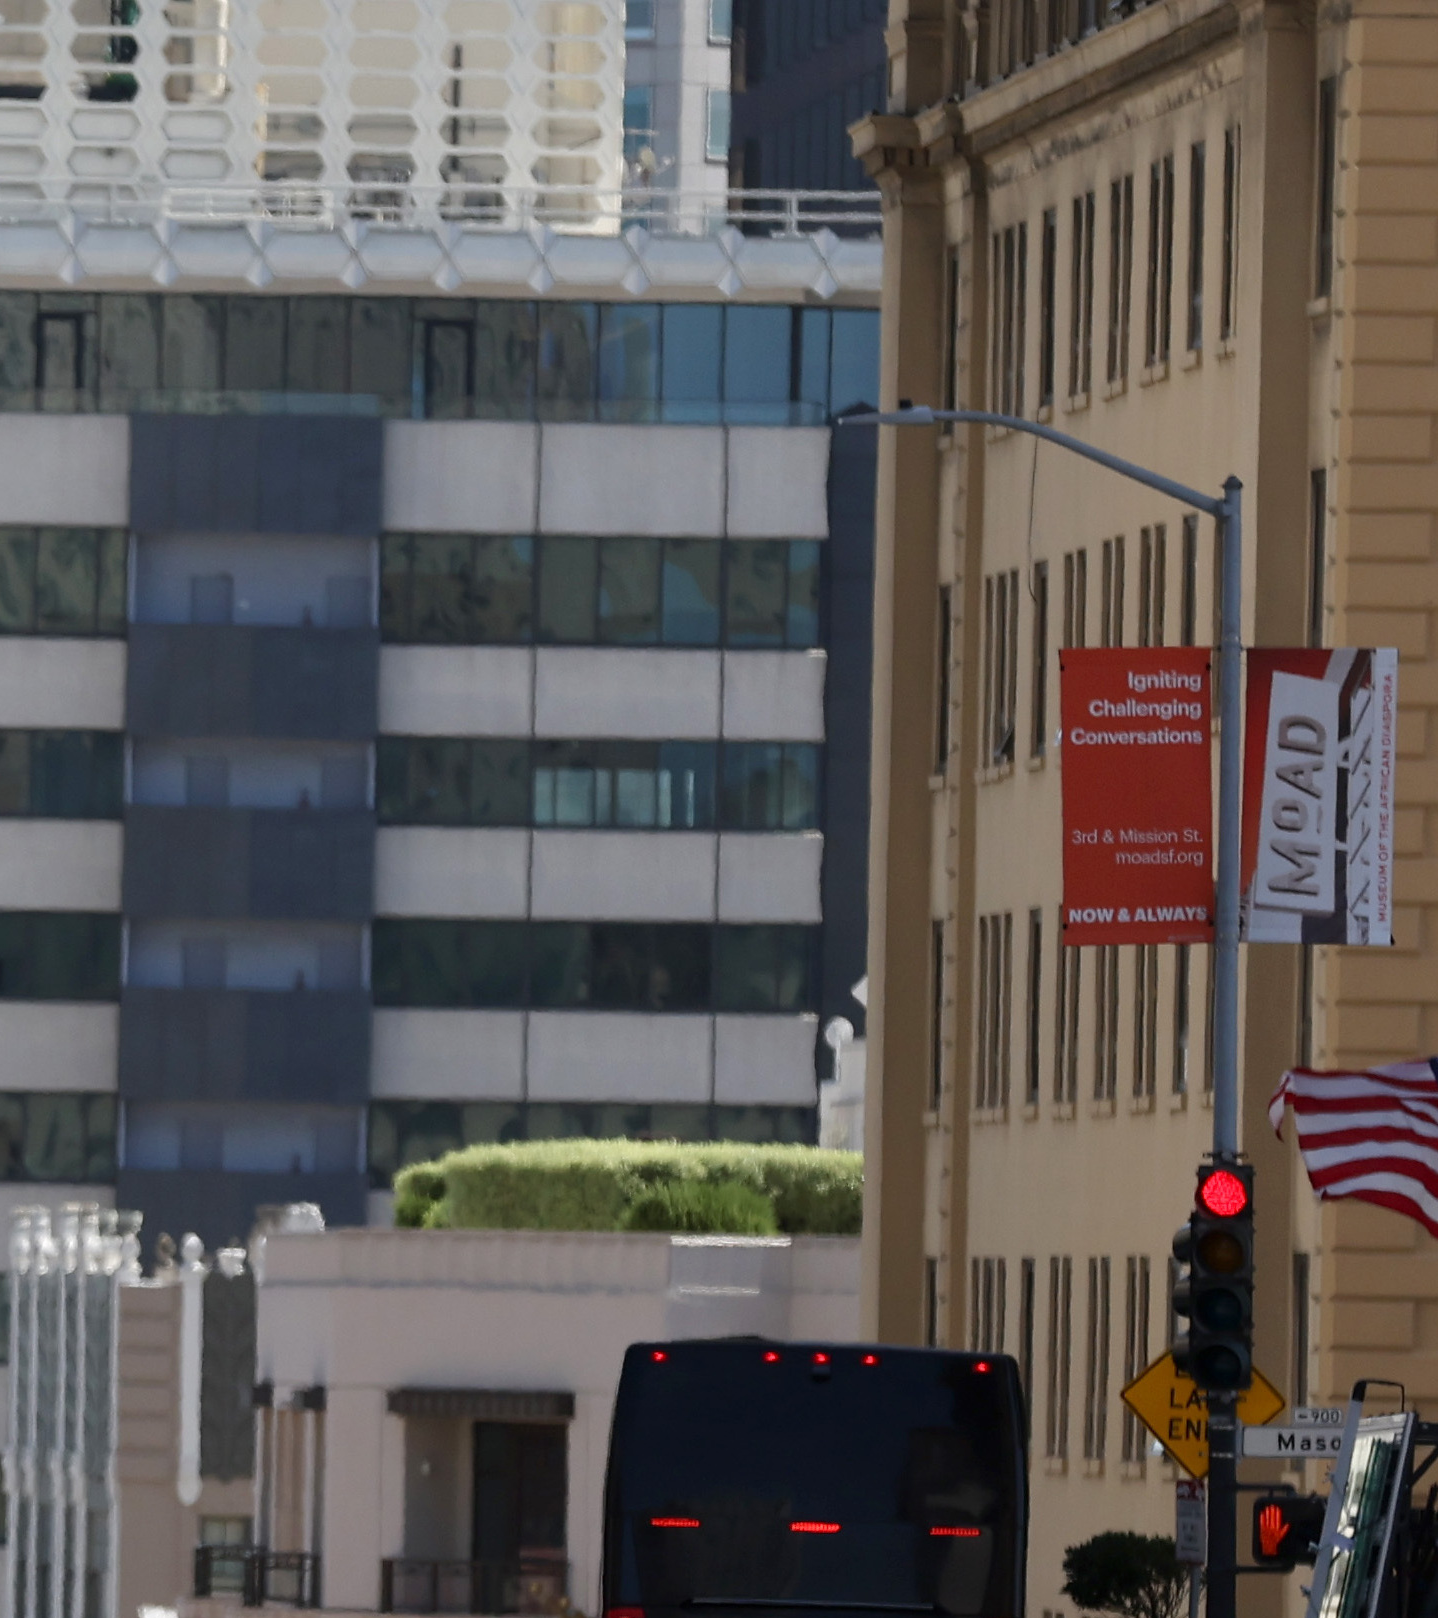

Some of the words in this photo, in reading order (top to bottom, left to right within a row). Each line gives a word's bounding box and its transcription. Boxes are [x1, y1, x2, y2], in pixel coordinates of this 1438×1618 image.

[1128, 671, 1202, 692] Igniting
[1089, 699, 1202, 720] Challenging
[1382, 674, 1393, 747] DIASPORA
[1070, 728, 1203, 746] Conversations
[1380, 750, 1391, 810] AFRICAN
[1072, 829, 1098, 844] 3rd
[1103, 829, 1115, 844] &
[1120, 828, 1178, 844] Mission
[1183, 828, 1203, 843] St.
[1380, 818, 1389, 843] THE
[1116, 849, 1204, 866] moadsf.org
[1379, 844, 1388, 864] OF
[1378, 867, 1388, 923] MUSEUM
[1069, 908, 1114, 923] NOW
[1118, 908, 1131, 922] &
[1134, 907, 1207, 922] ALWAYS
[1312, 1411, 1340, 1423] 900
[1278, 1434, 1341, 1451] Maso
